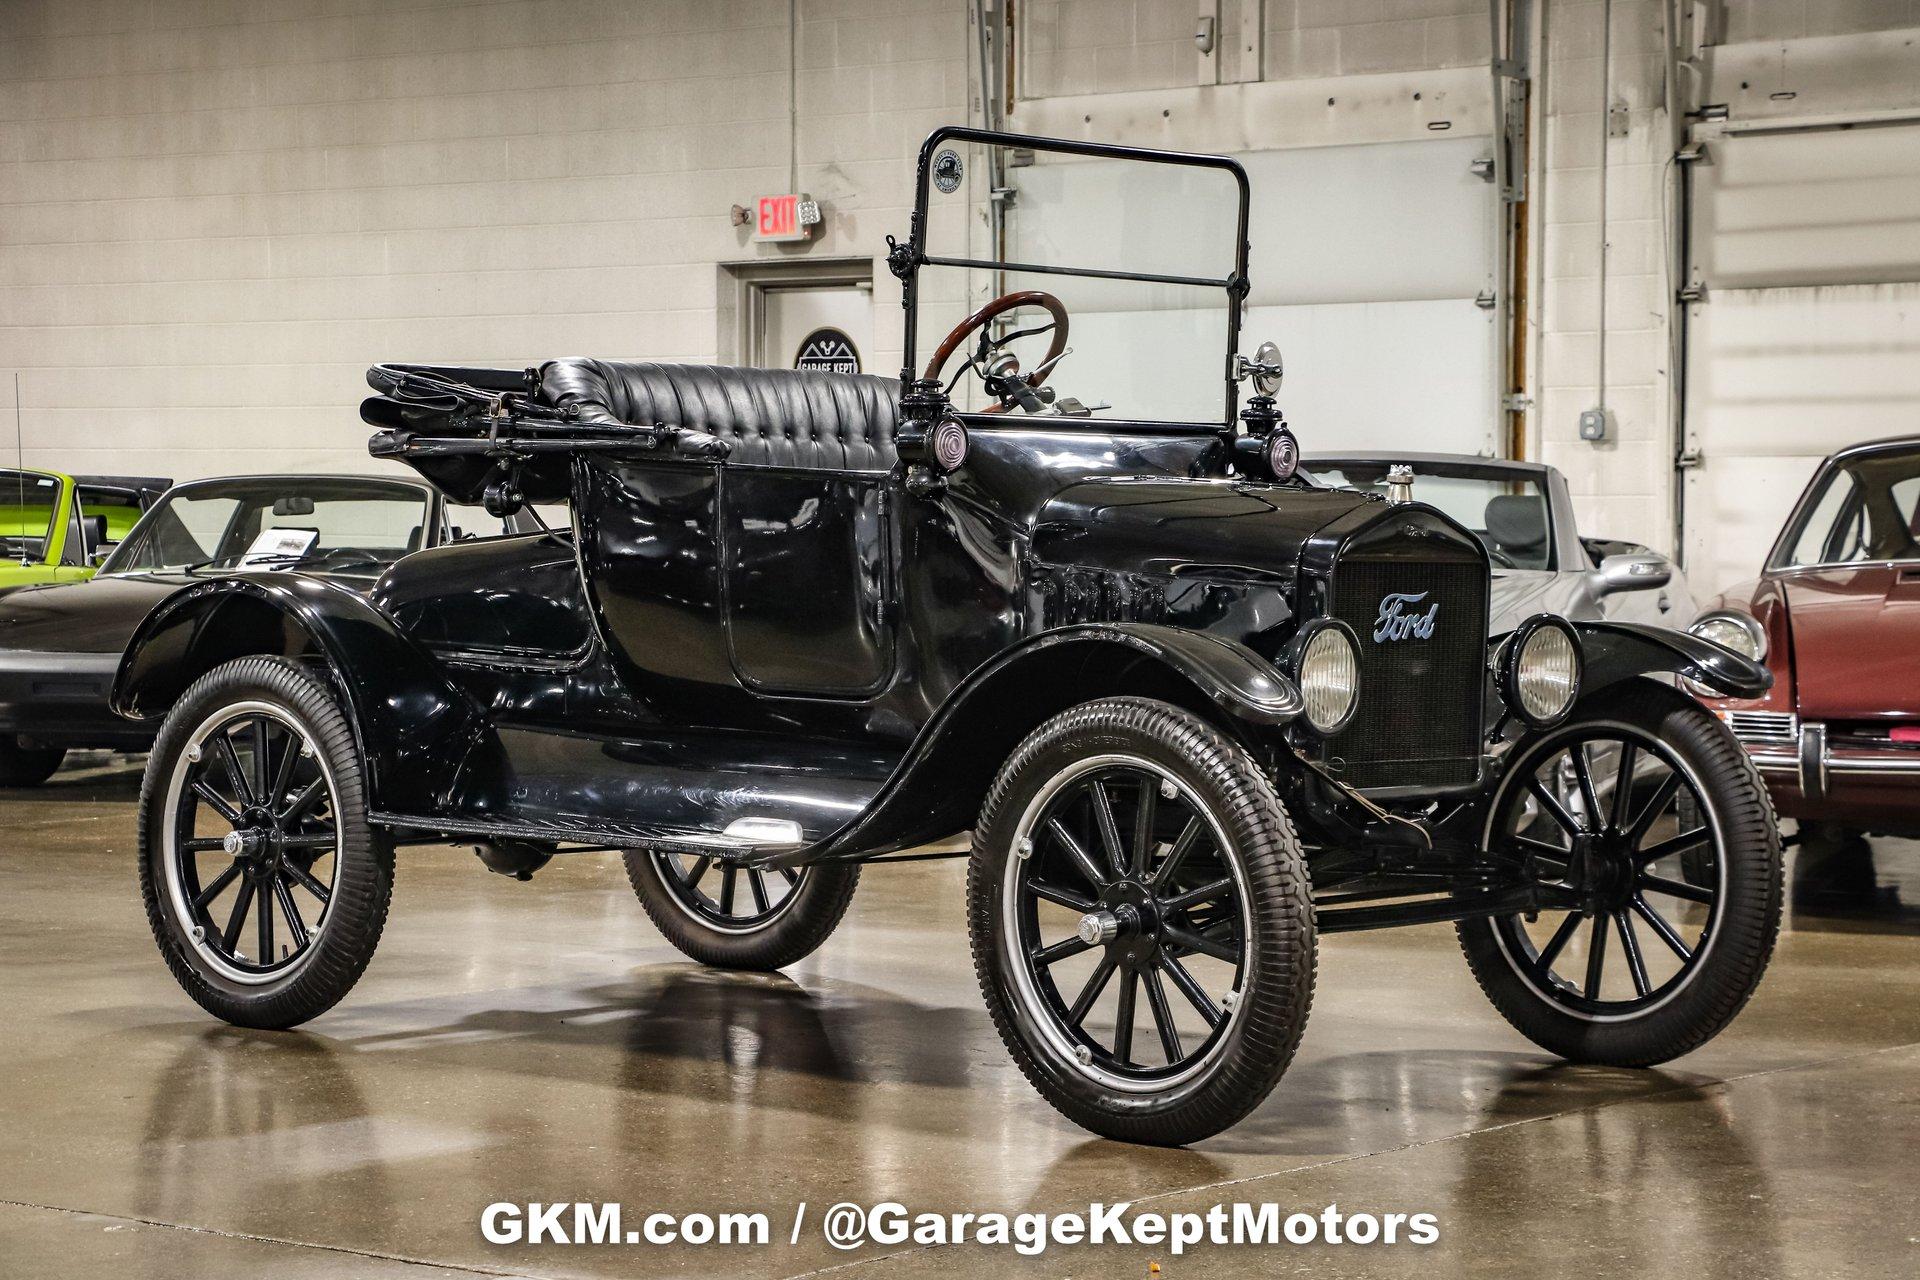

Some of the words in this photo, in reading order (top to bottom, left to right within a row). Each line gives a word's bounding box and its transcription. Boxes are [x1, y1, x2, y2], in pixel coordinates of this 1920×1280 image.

[759, 195, 798, 236] EXIT
[833, 362, 854, 374] KEPT
[1373, 590, 1439, 644] Ford
